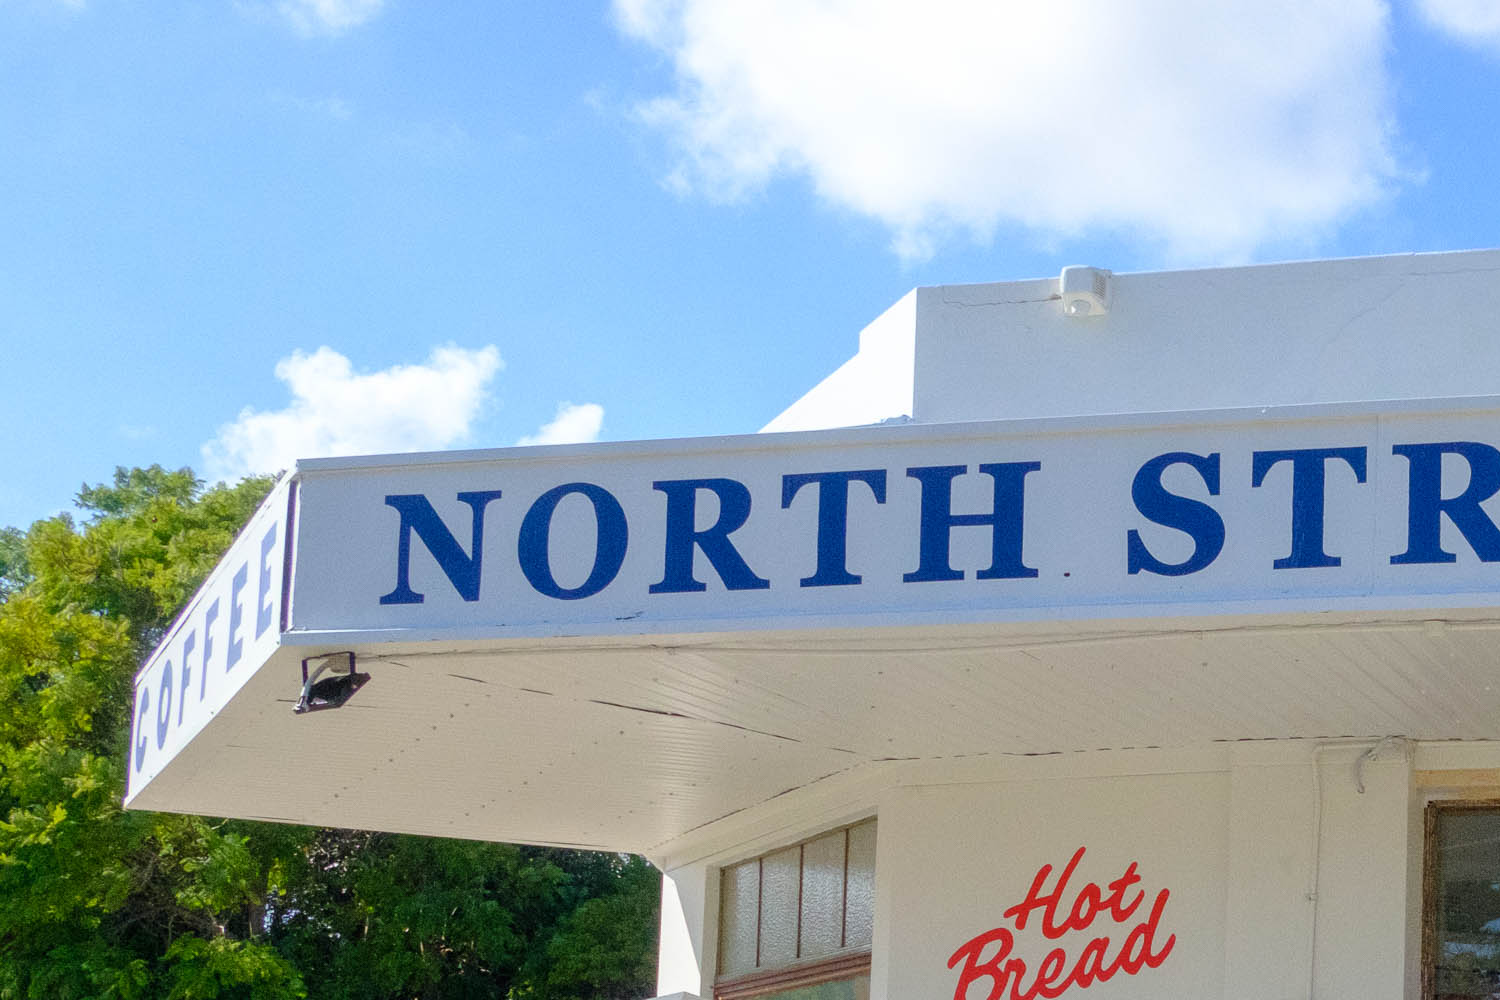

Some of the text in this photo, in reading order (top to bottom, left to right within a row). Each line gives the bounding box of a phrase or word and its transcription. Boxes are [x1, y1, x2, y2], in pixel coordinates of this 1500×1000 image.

[380, 461, 1041, 605] NORTH
[135, 521, 278, 774] COFFEE
[1003, 846, 1145, 940] Hot
